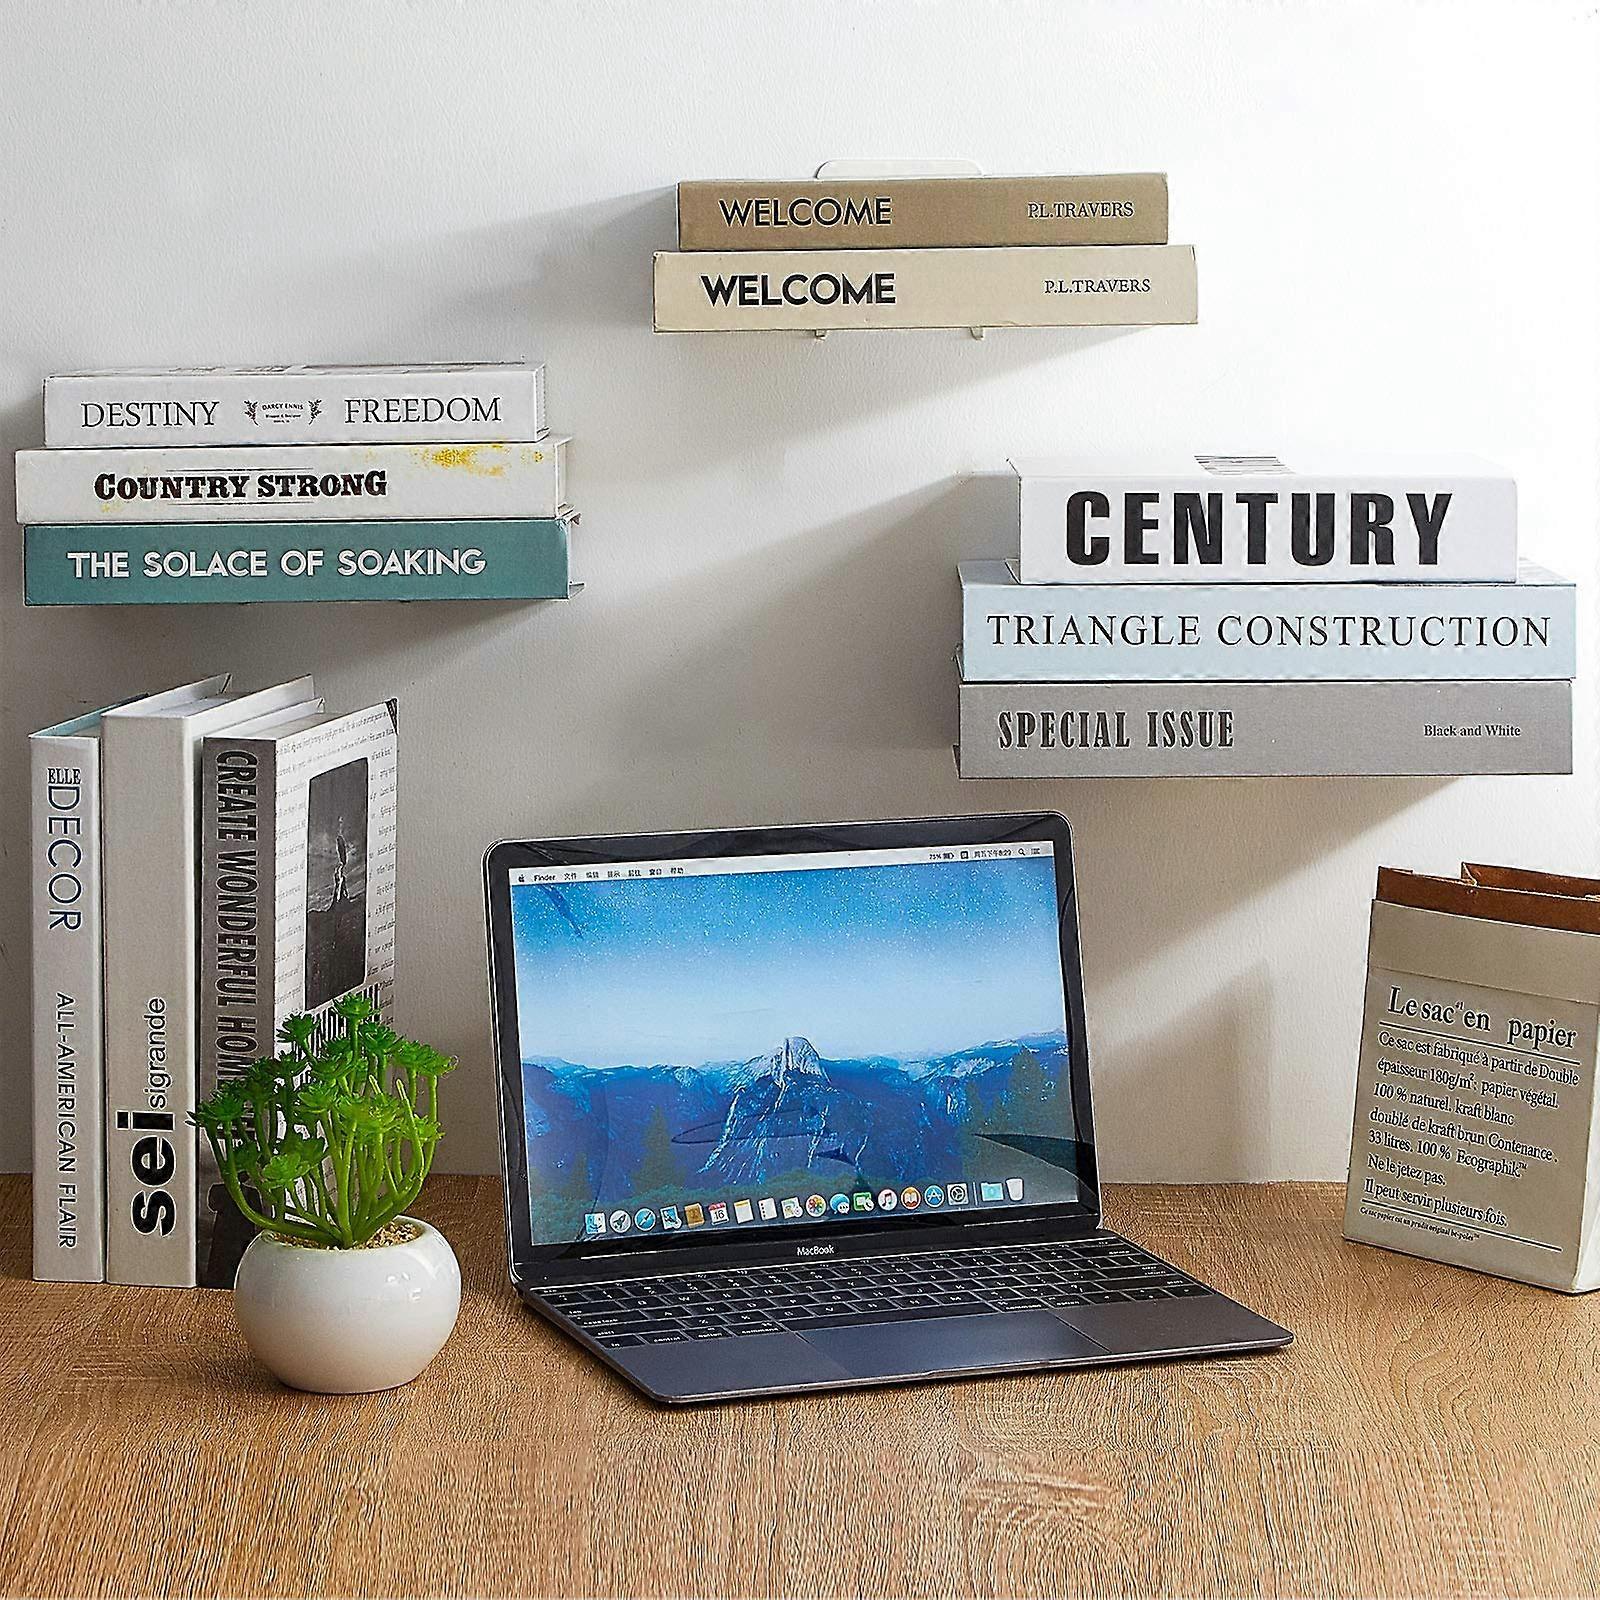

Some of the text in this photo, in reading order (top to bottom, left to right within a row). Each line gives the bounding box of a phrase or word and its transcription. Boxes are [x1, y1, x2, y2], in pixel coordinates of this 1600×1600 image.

[719, 197, 892, 226] WELCOME
[701, 273, 895, 306] WELCOME
[1044, 278, 1151, 293] P.L.TRAVERS
[81, 401, 220, 428] DESTINY
[344, 396, 501, 424] FREEDOM
[94, 470, 388, 500] COUNTRY STRONG
[1066, 490, 1453, 567] CENTURY
[67, 548, 486, 578] THE SOLACE OF SOAKING
[987, 614, 1552, 649] TRIANGLE CONSTRUCTION
[998, 711, 1235, 750] SPECIAL ISSUE
[1424, 724, 1521, 737] Black and White
[47, 767, 81, 785] ELLE
[215, 750, 259, 843] CREATE
[47, 785, 82, 930] DECOR
[533, 874, 556, 882] Finder
[215, 851, 259, 1006] WONDERFUL
[1387, 985, 1418, 1017] Le
[1421, 1002, 1455, 1024] sac
[1463, 1010, 1491, 1032] en
[1506, 1018, 1577, 1050] papier
[1378, 1032, 1580, 1086] Ce sac est fabriqué à partir de Double
[1377, 1058, 1428, 1080] épaisseur
[1480, 1081, 1518, 1100] papier
[56, 991, 77, 1249] ALL-AMERICAN FLAIR
[116, 997, 176, 1237] sei sigrande
[1373, 1082, 1394, 1099] 100
[1397, 1087, 1407, 1101] %
[1455, 1099, 1482, 1119] kraft
[1484, 1104, 1515, 1126] blanc
[1370, 1107, 1409, 1127] doublé
[1411, 1115, 1426, 1131] de
[1428, 1119, 1456, 1139] kraft
[1457, 1125, 1485, 1145] brun
[1368, 1130, 1381, 1145] 33
[1416, 1139, 1437, 1156] 100
[1439, 1144, 1451, 1160] %
[1367, 1153, 1446, 1186] Ne le jetez pas.
[1364, 1178, 1508, 1227] Il peut servir plusieurs fois.
[797, 1244, 834, 1257] MacBook
